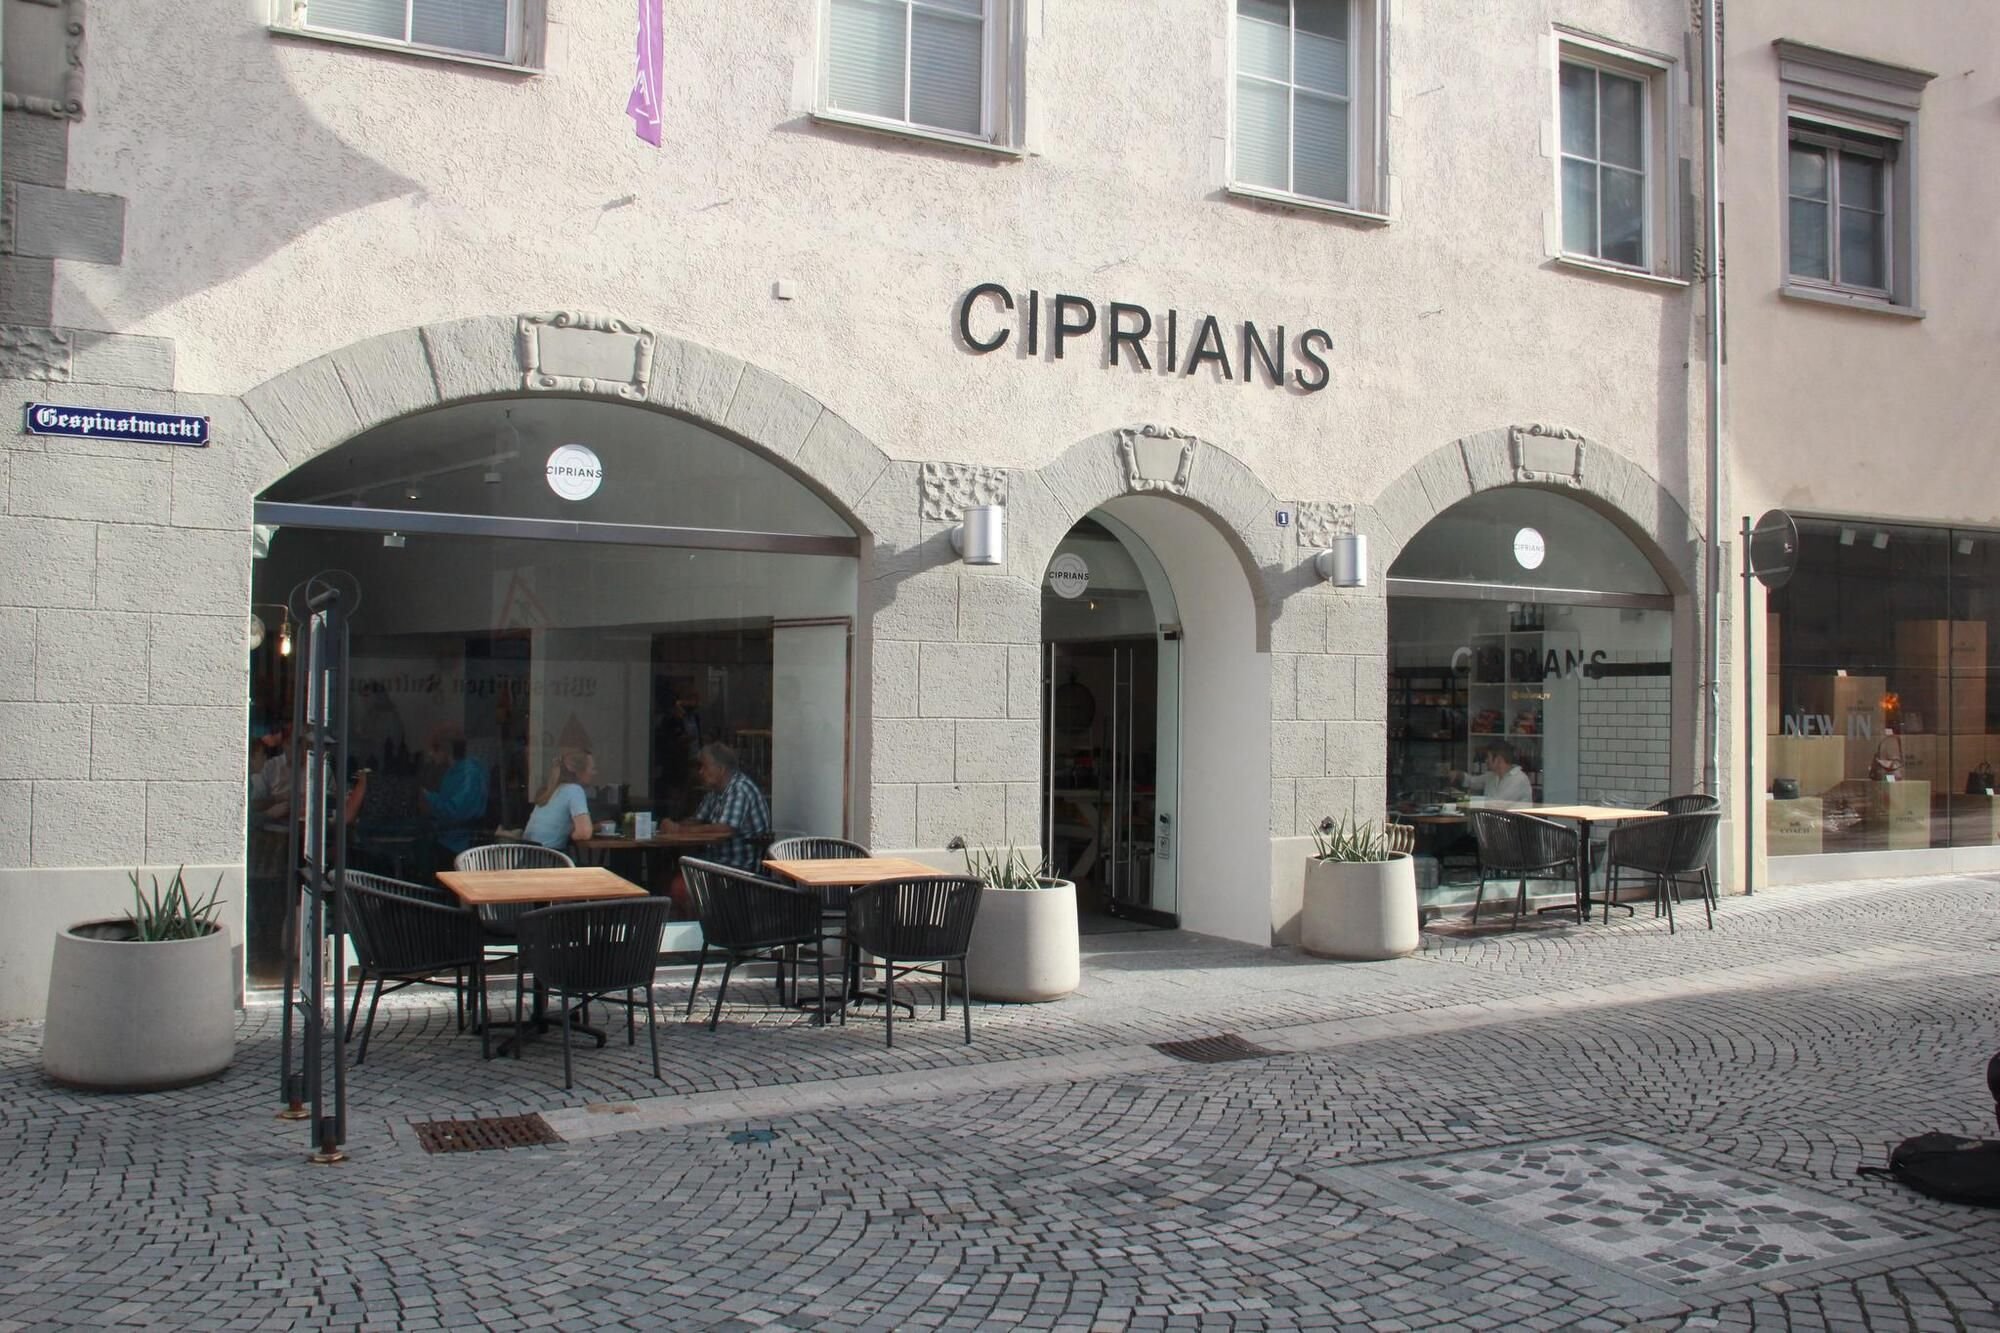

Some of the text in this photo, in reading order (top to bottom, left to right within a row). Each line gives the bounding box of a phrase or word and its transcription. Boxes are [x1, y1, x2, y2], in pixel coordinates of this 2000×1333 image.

[960, 283, 1333, 391] CIPRIANS
[36, 407, 201, 437] Gespinstmarkt
[546, 466, 602, 479] CIPRIANS
[1048, 571, 1090, 581] CIPRIANS
[1452, 647, 1607, 681] CRIANS
[1784, 714, 1872, 740] NEW IN
